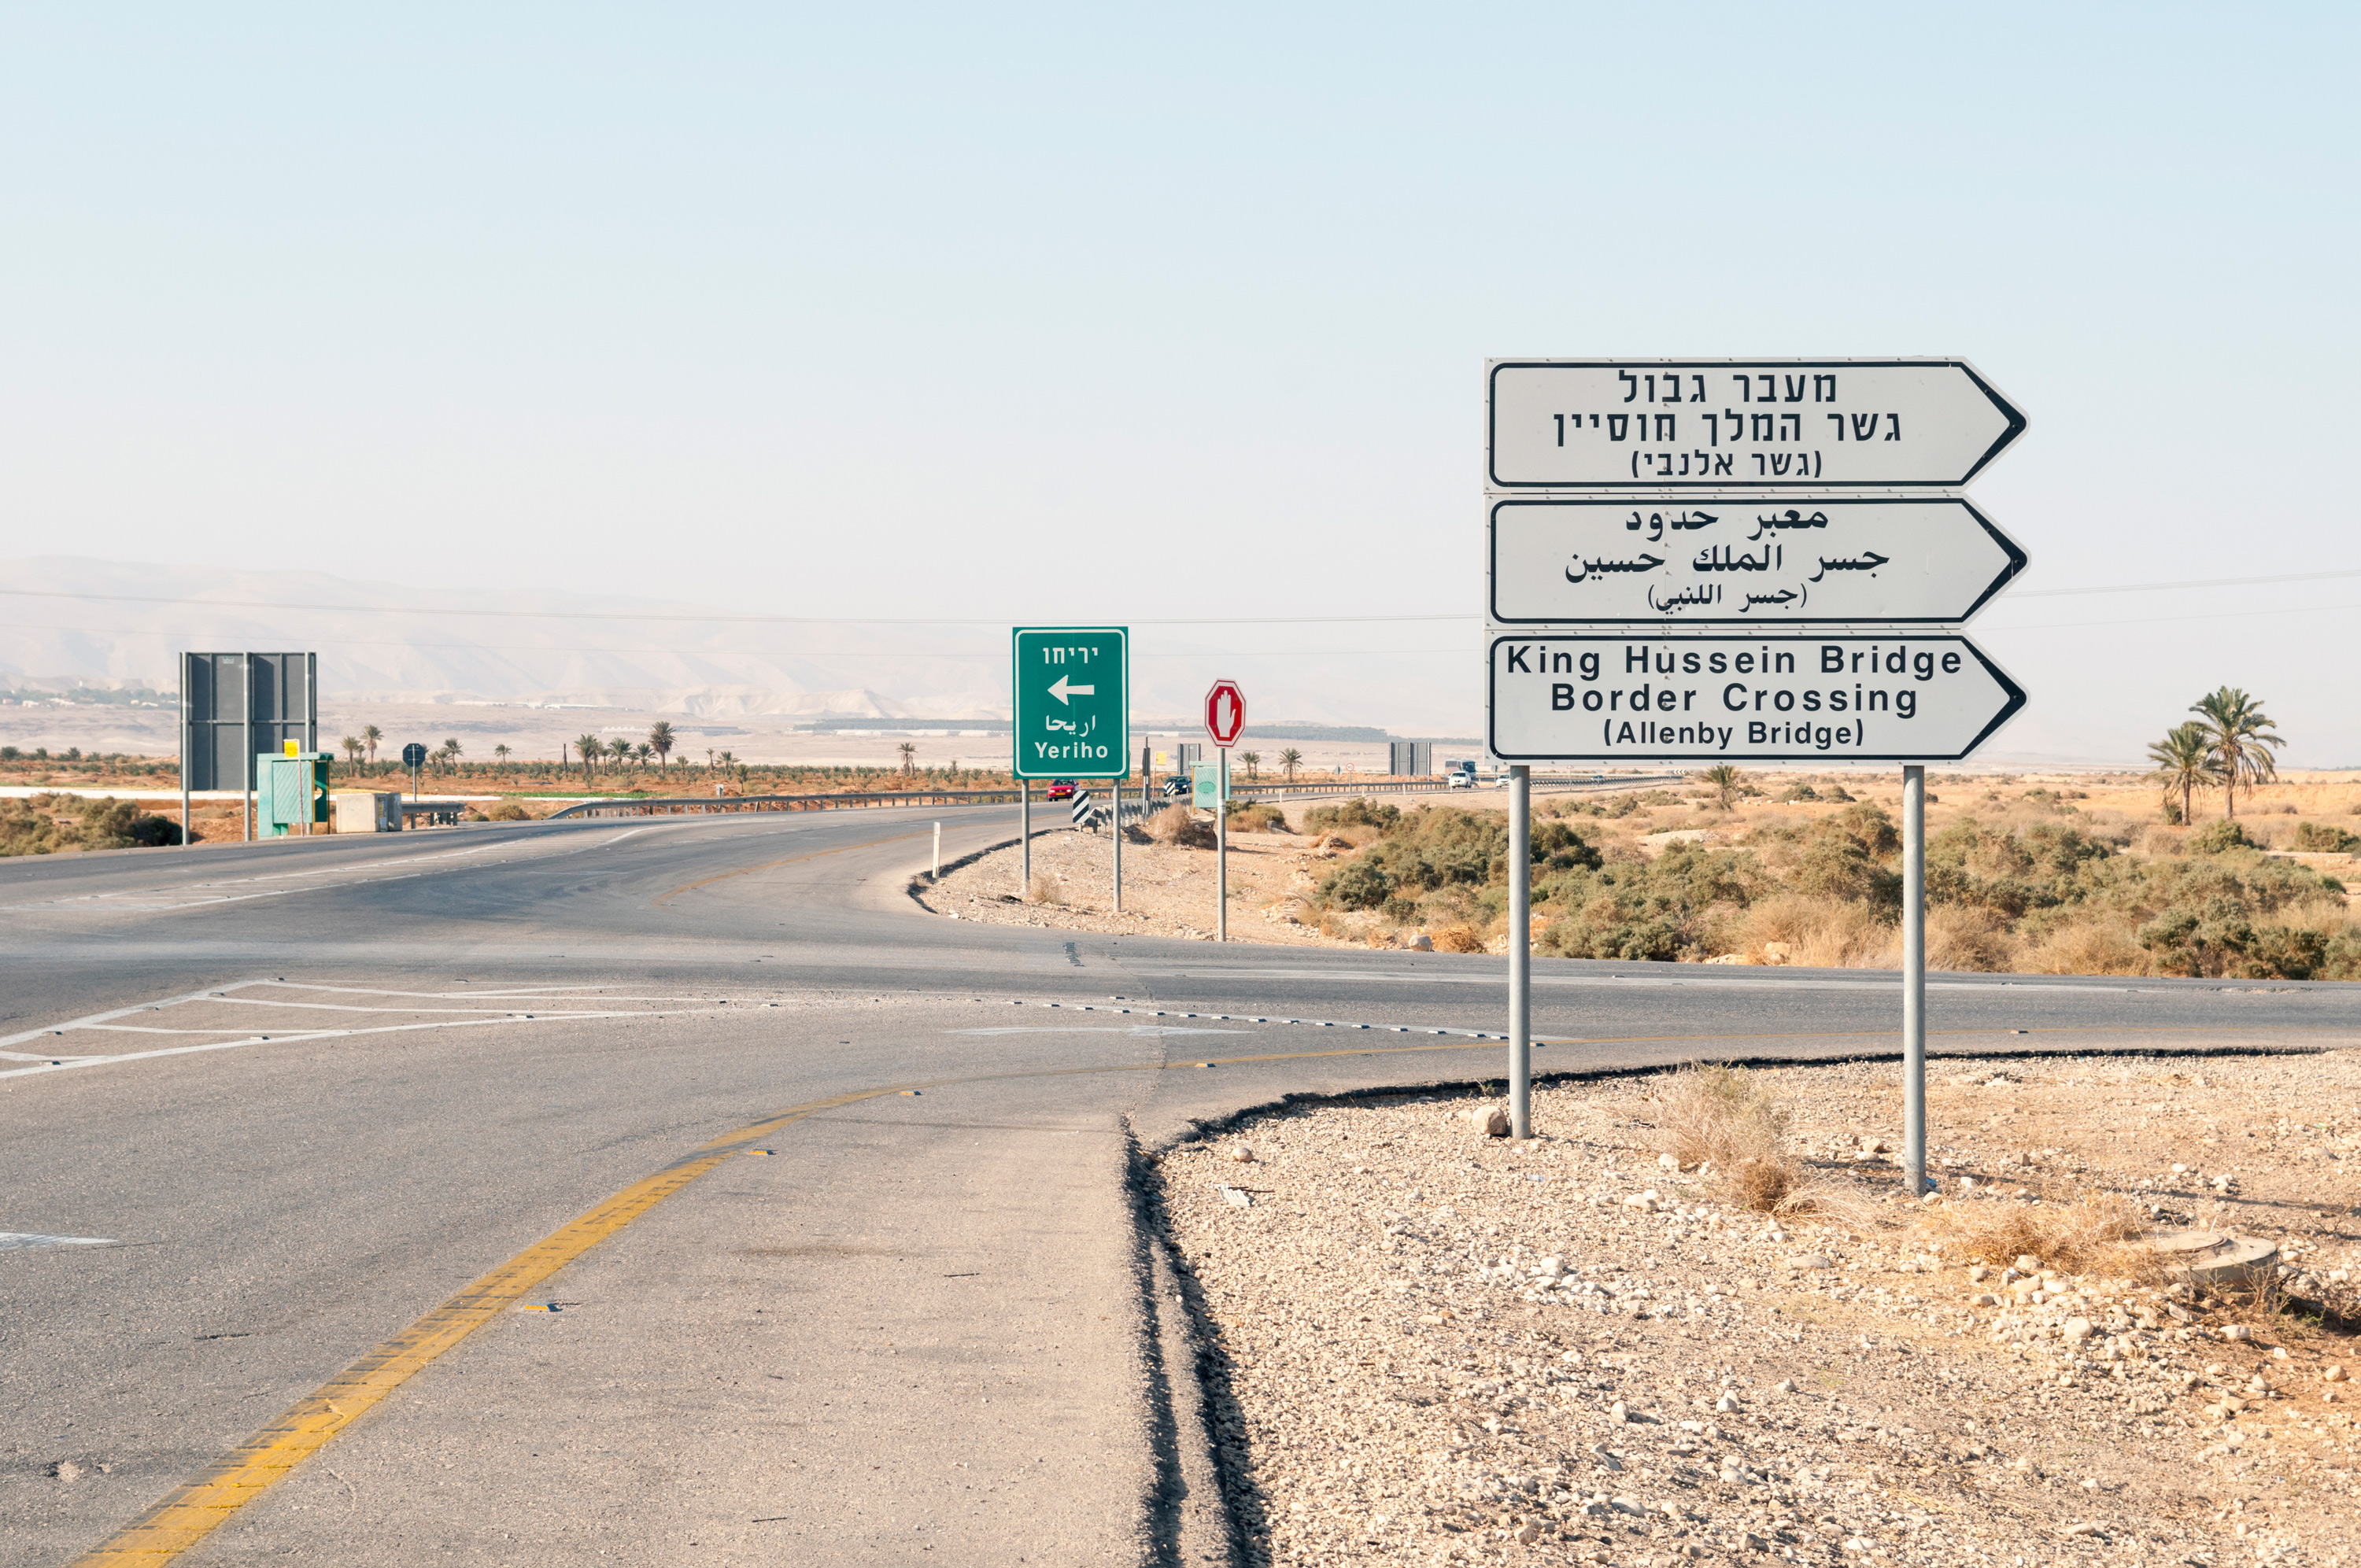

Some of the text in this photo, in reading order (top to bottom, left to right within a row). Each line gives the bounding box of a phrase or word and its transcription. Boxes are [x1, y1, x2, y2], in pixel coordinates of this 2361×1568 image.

[1619, 369, 1835, 402] מעבר גבול
[1554, 408, 1900, 446] גשר המלך חוסיין
[1627, 509, 1828, 542] معبر حدود
[1565, 544, 1890, 583] جسر الملك حسين
[1043, 647, 1098, 664] יריחו
[1509, 646, 1960, 681] King Hussein Bridge
[1553, 683, 1916, 719] Border Crossing
[1045, 714, 1096, 737] اريحا
[1605, 719, 1863, 750] (Allenby Bridge)
[1034, 741, 1108, 758] Yeriho
